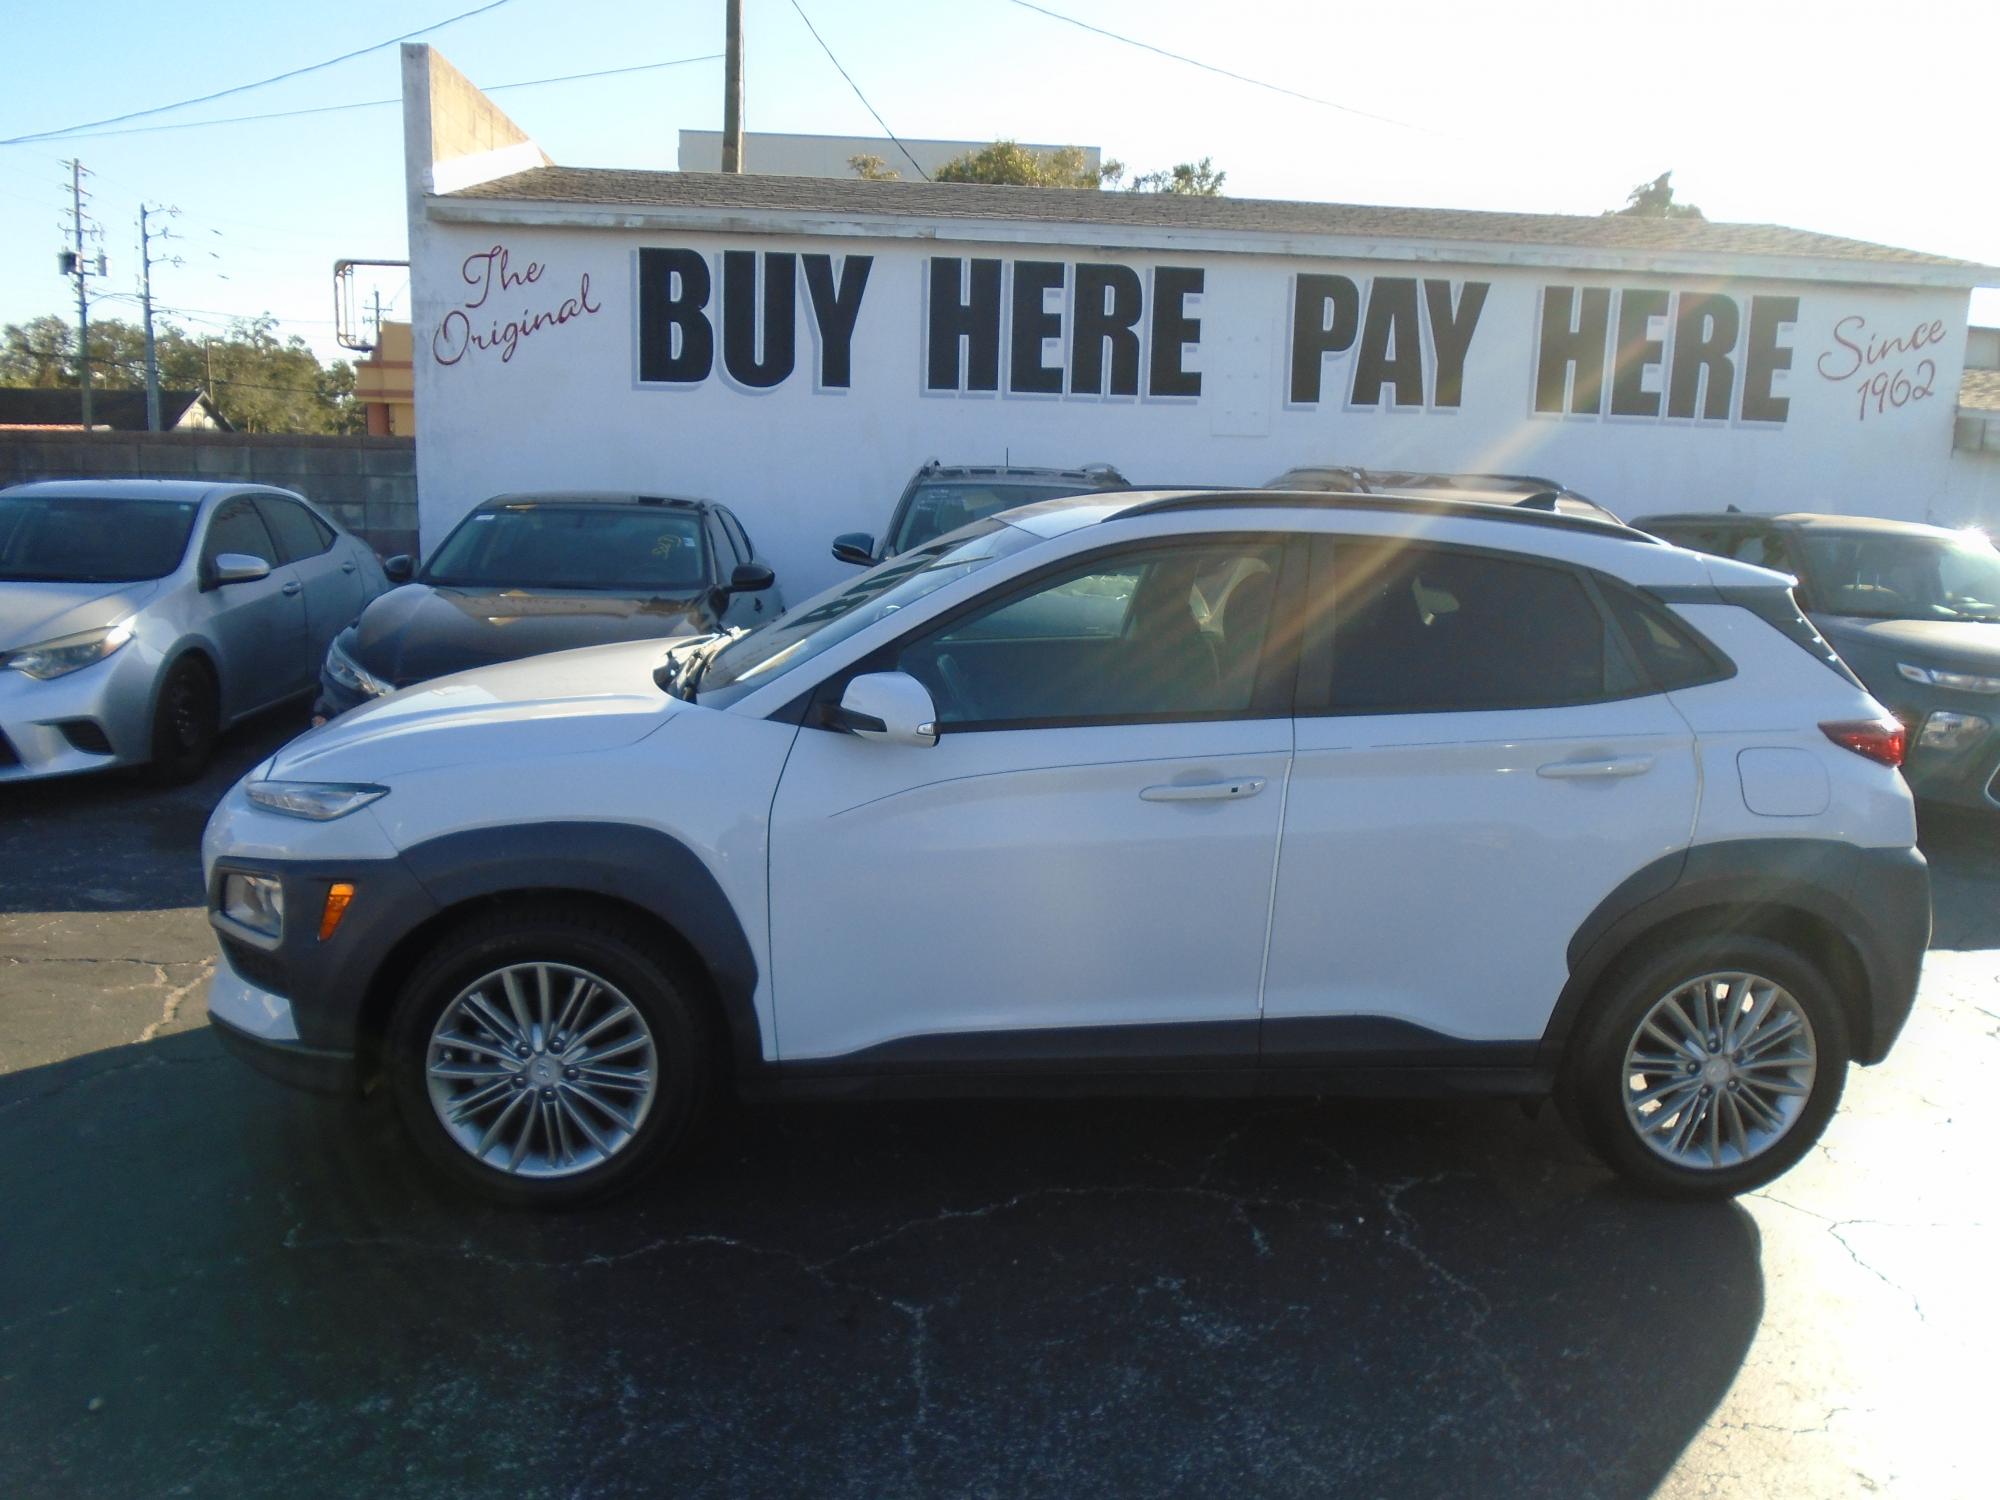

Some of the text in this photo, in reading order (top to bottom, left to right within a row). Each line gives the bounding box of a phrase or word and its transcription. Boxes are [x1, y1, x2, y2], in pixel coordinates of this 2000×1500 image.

[462, 245, 546, 308] The
[432, 273, 601, 366] Original
[638, 246, 1800, 423] BUY HERE PAY HERE
[1817, 315, 1947, 381] Since
[1857, 358, 1935, 422] 1962
